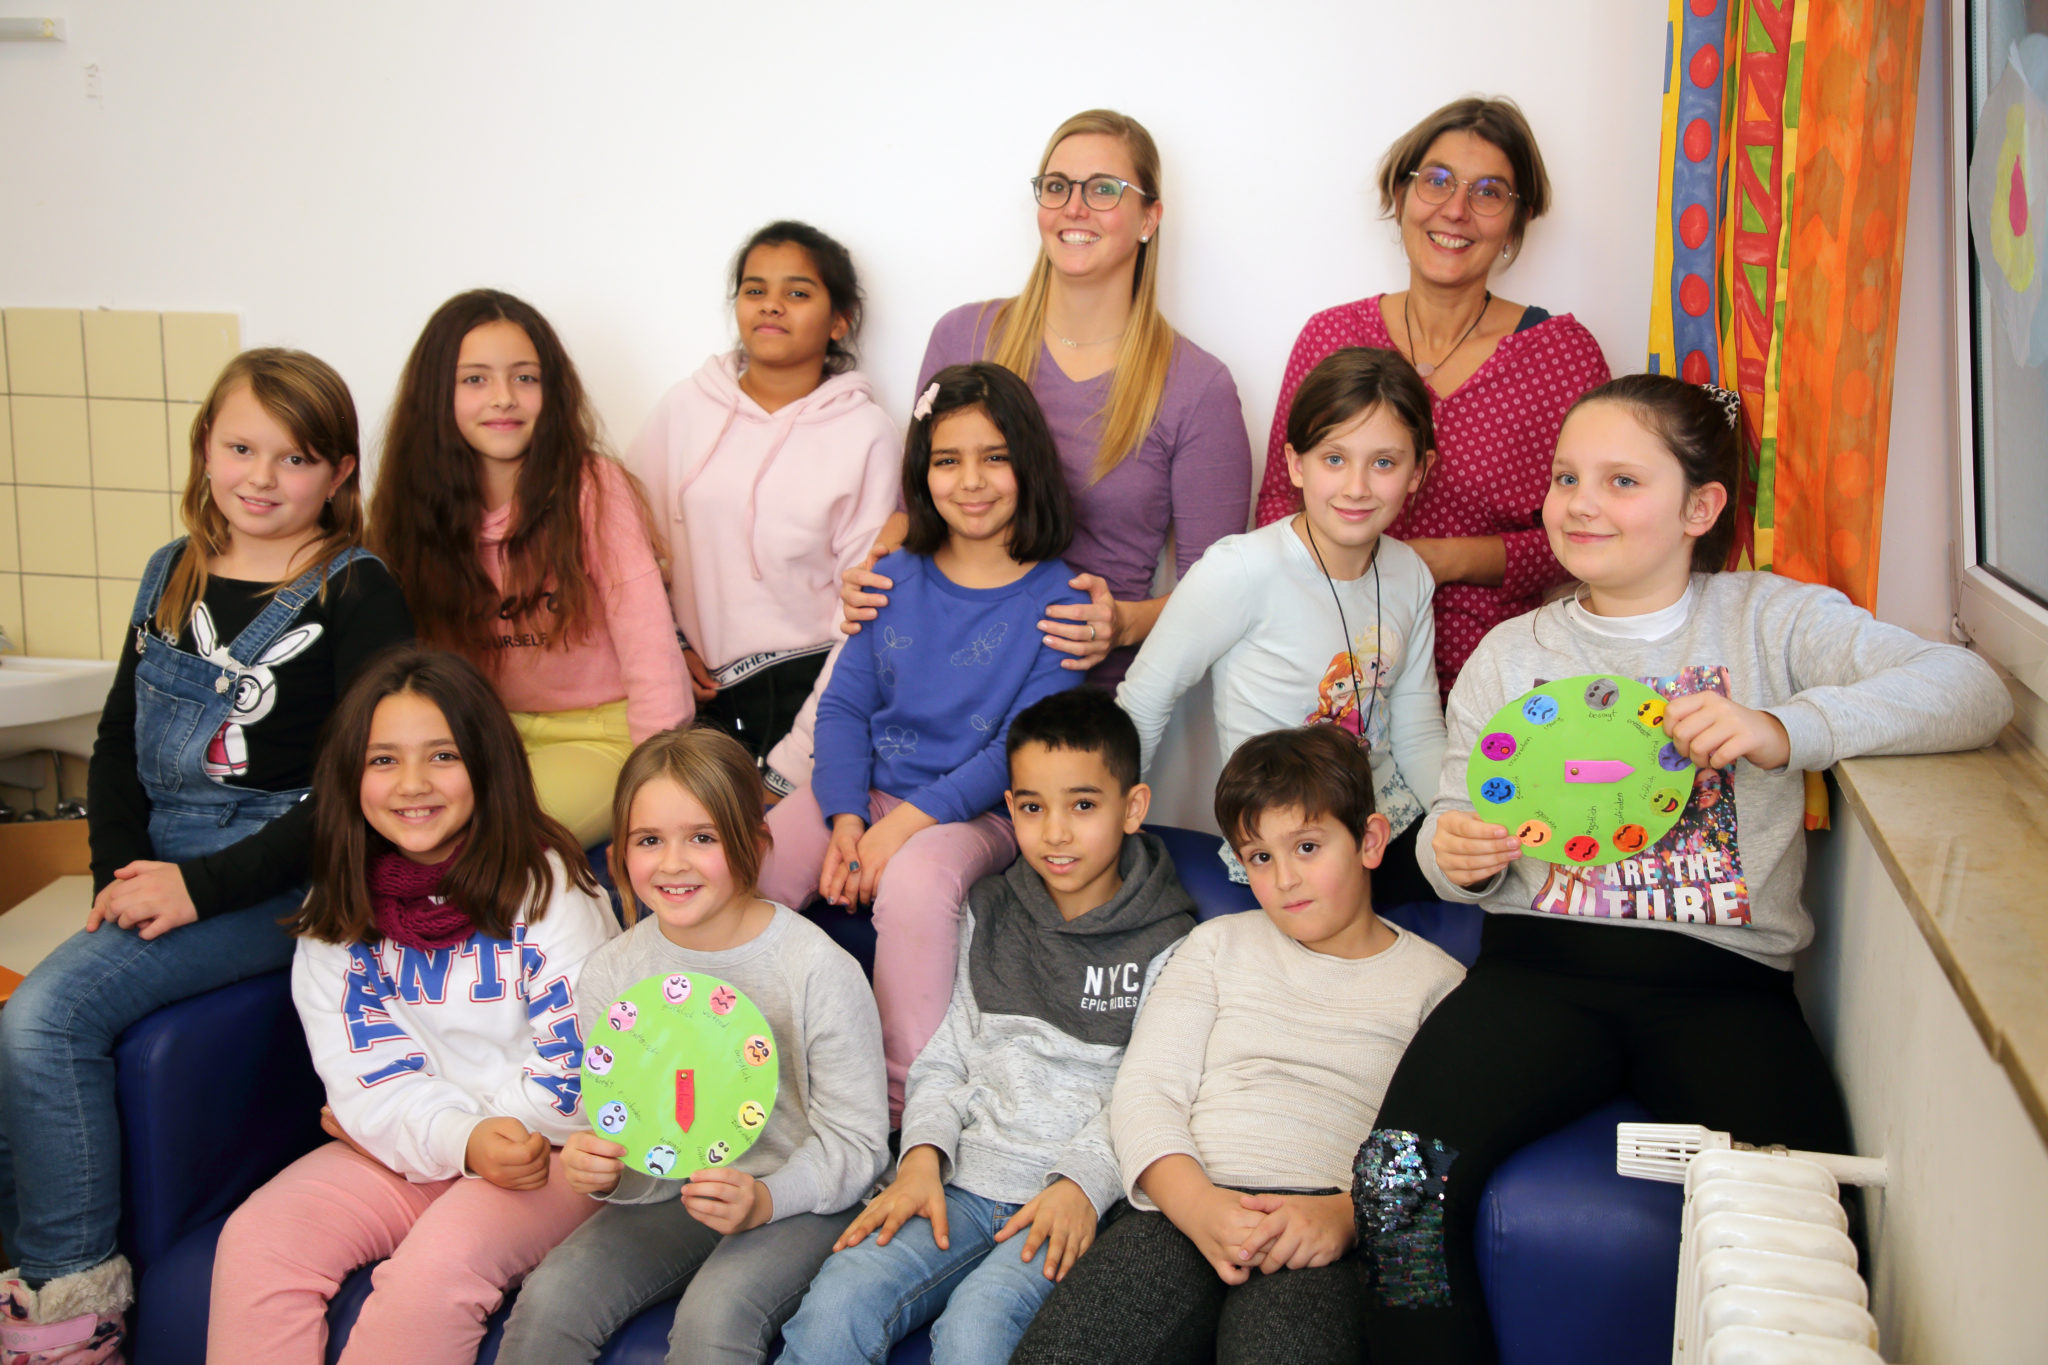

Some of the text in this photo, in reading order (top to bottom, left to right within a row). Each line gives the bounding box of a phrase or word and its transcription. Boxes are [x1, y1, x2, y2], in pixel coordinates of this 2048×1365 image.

[1604, 858, 1661, 887] ARE
[1670, 851, 1724, 883] THE
[1539, 870, 1743, 927] FUTURE
[1083, 962, 1140, 996] NYC
[1080, 997, 1108, 1012] EPIC
